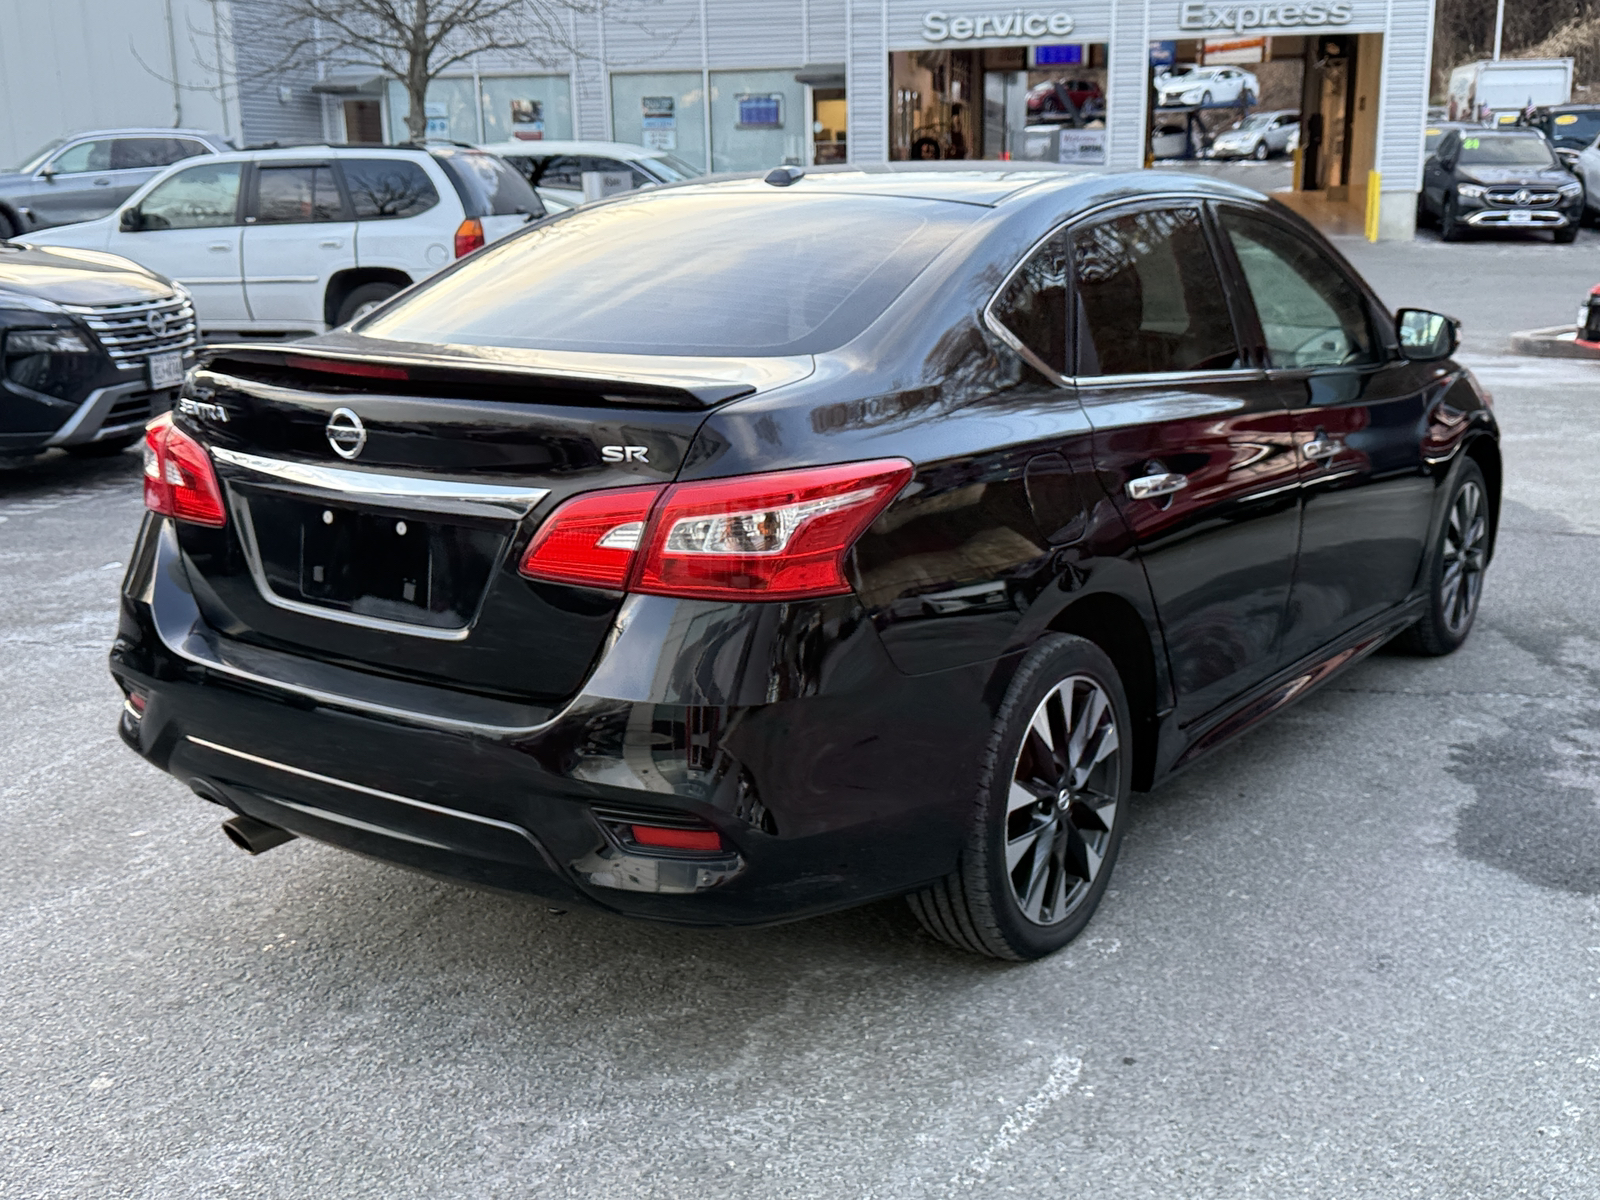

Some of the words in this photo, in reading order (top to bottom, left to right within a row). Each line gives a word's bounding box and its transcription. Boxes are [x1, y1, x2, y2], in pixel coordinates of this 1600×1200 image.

[922, 9, 1075, 42] Service
[1179, 0, 1352, 34] Express
[601, 445, 650, 463] SR
